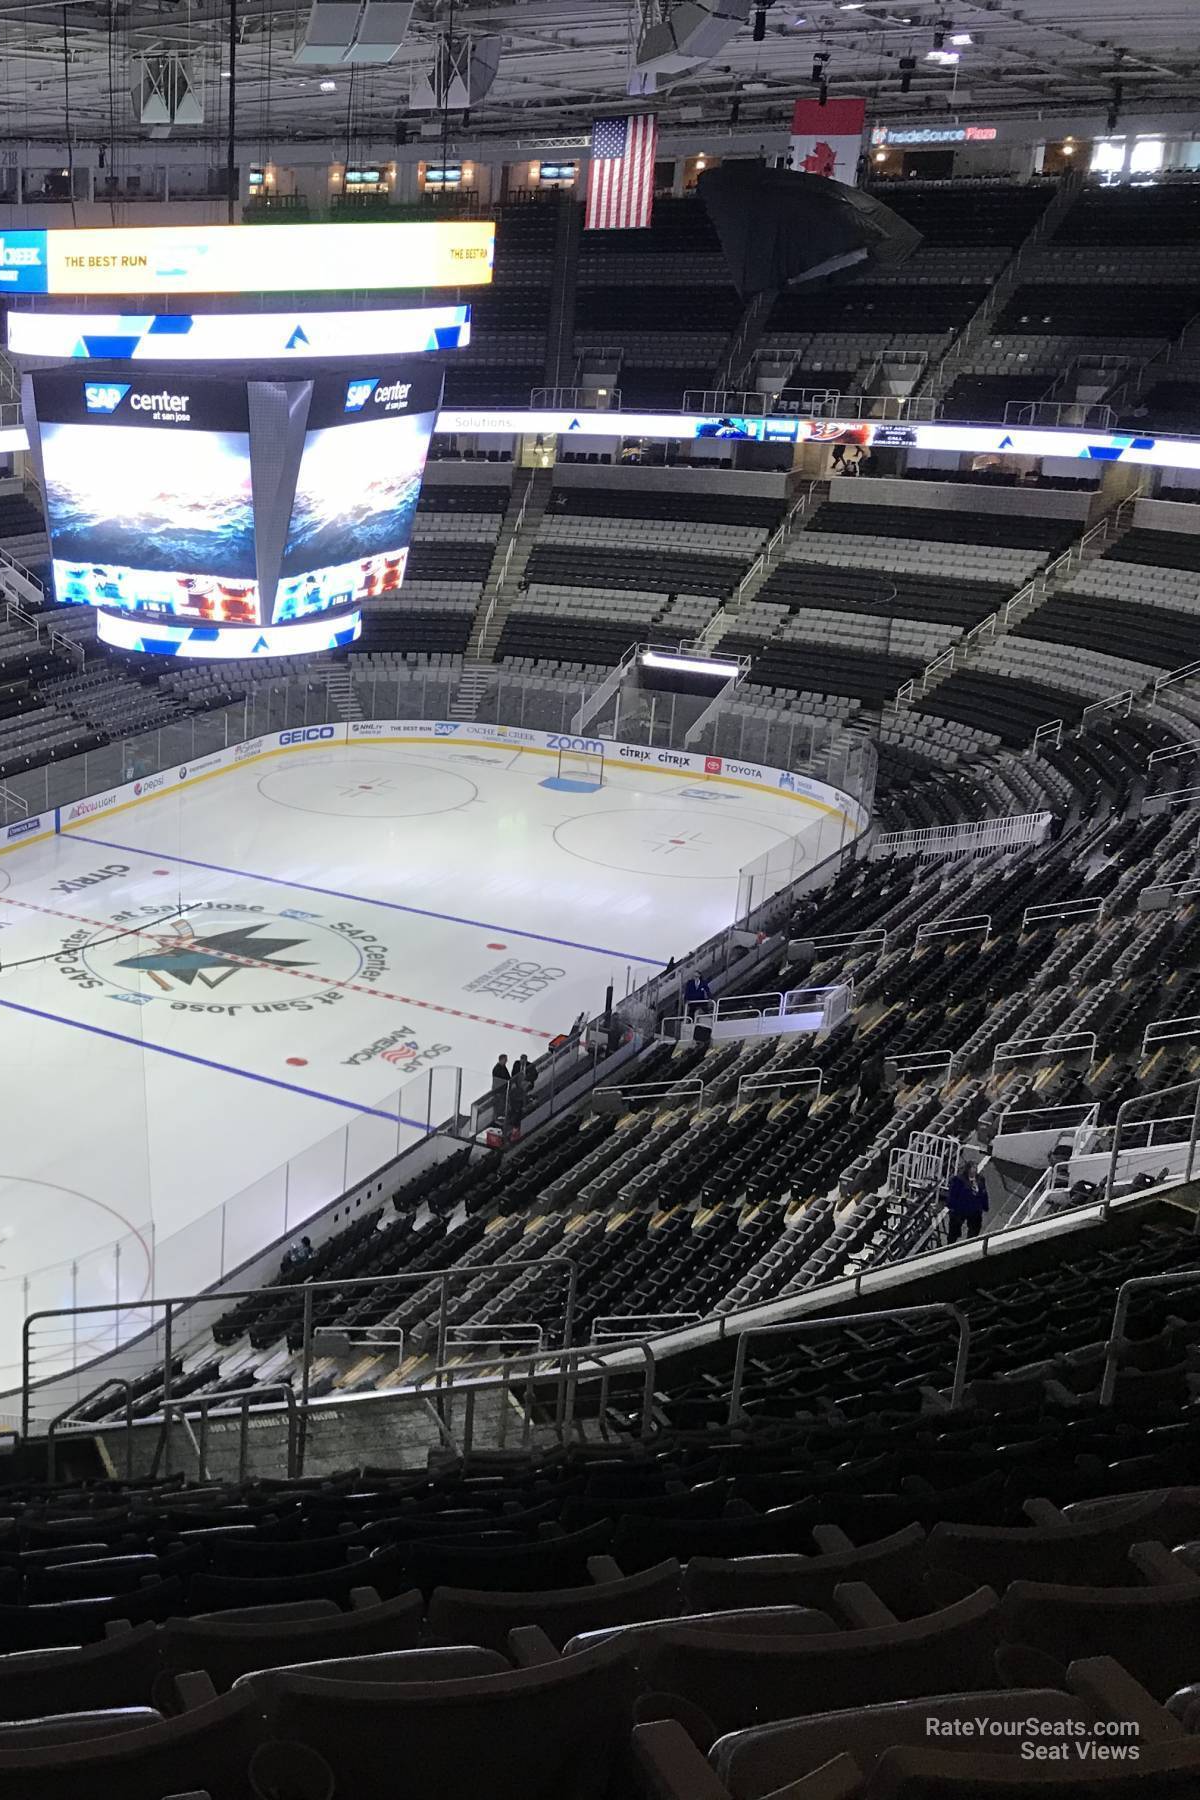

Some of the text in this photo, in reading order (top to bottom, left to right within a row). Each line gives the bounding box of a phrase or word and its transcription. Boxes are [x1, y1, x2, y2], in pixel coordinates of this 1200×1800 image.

[887, 129, 965, 143] InsideSource
[966, 127, 997, 140] Plaza
[2, 151, 18, 166] 218
[65, 255, 148, 267] THE BEST RUN
[451, 248, 463, 259] THE
[86, 386, 190, 412] SAP center
[346, 382, 412, 407] SAP center
[153, 411, 191, 423] at san jose
[279, 727, 334, 745] GEICO
[435, 724, 455, 734] SAP
[466, 726, 496, 736] CACHE
[508, 730, 535, 741] CREEK
[546, 734, 605, 754] zoom
[726, 764, 762, 779] TOYOTA
[143, 775, 164, 793] pepsi
[97, 794, 117, 810] LIGHT
[60, 966, 104, 990] SAP
[110, 909, 138, 922] at
[201, 901, 265, 912] Jose
[169, 921, 392, 1017] SAP Center at San Jose
[473, 961, 542, 997] CREEK
[500, 967, 566, 1003] CACHE
[340, 1025, 417, 1065] AMERICA
[397, 1043, 452, 1073] SOLAR
